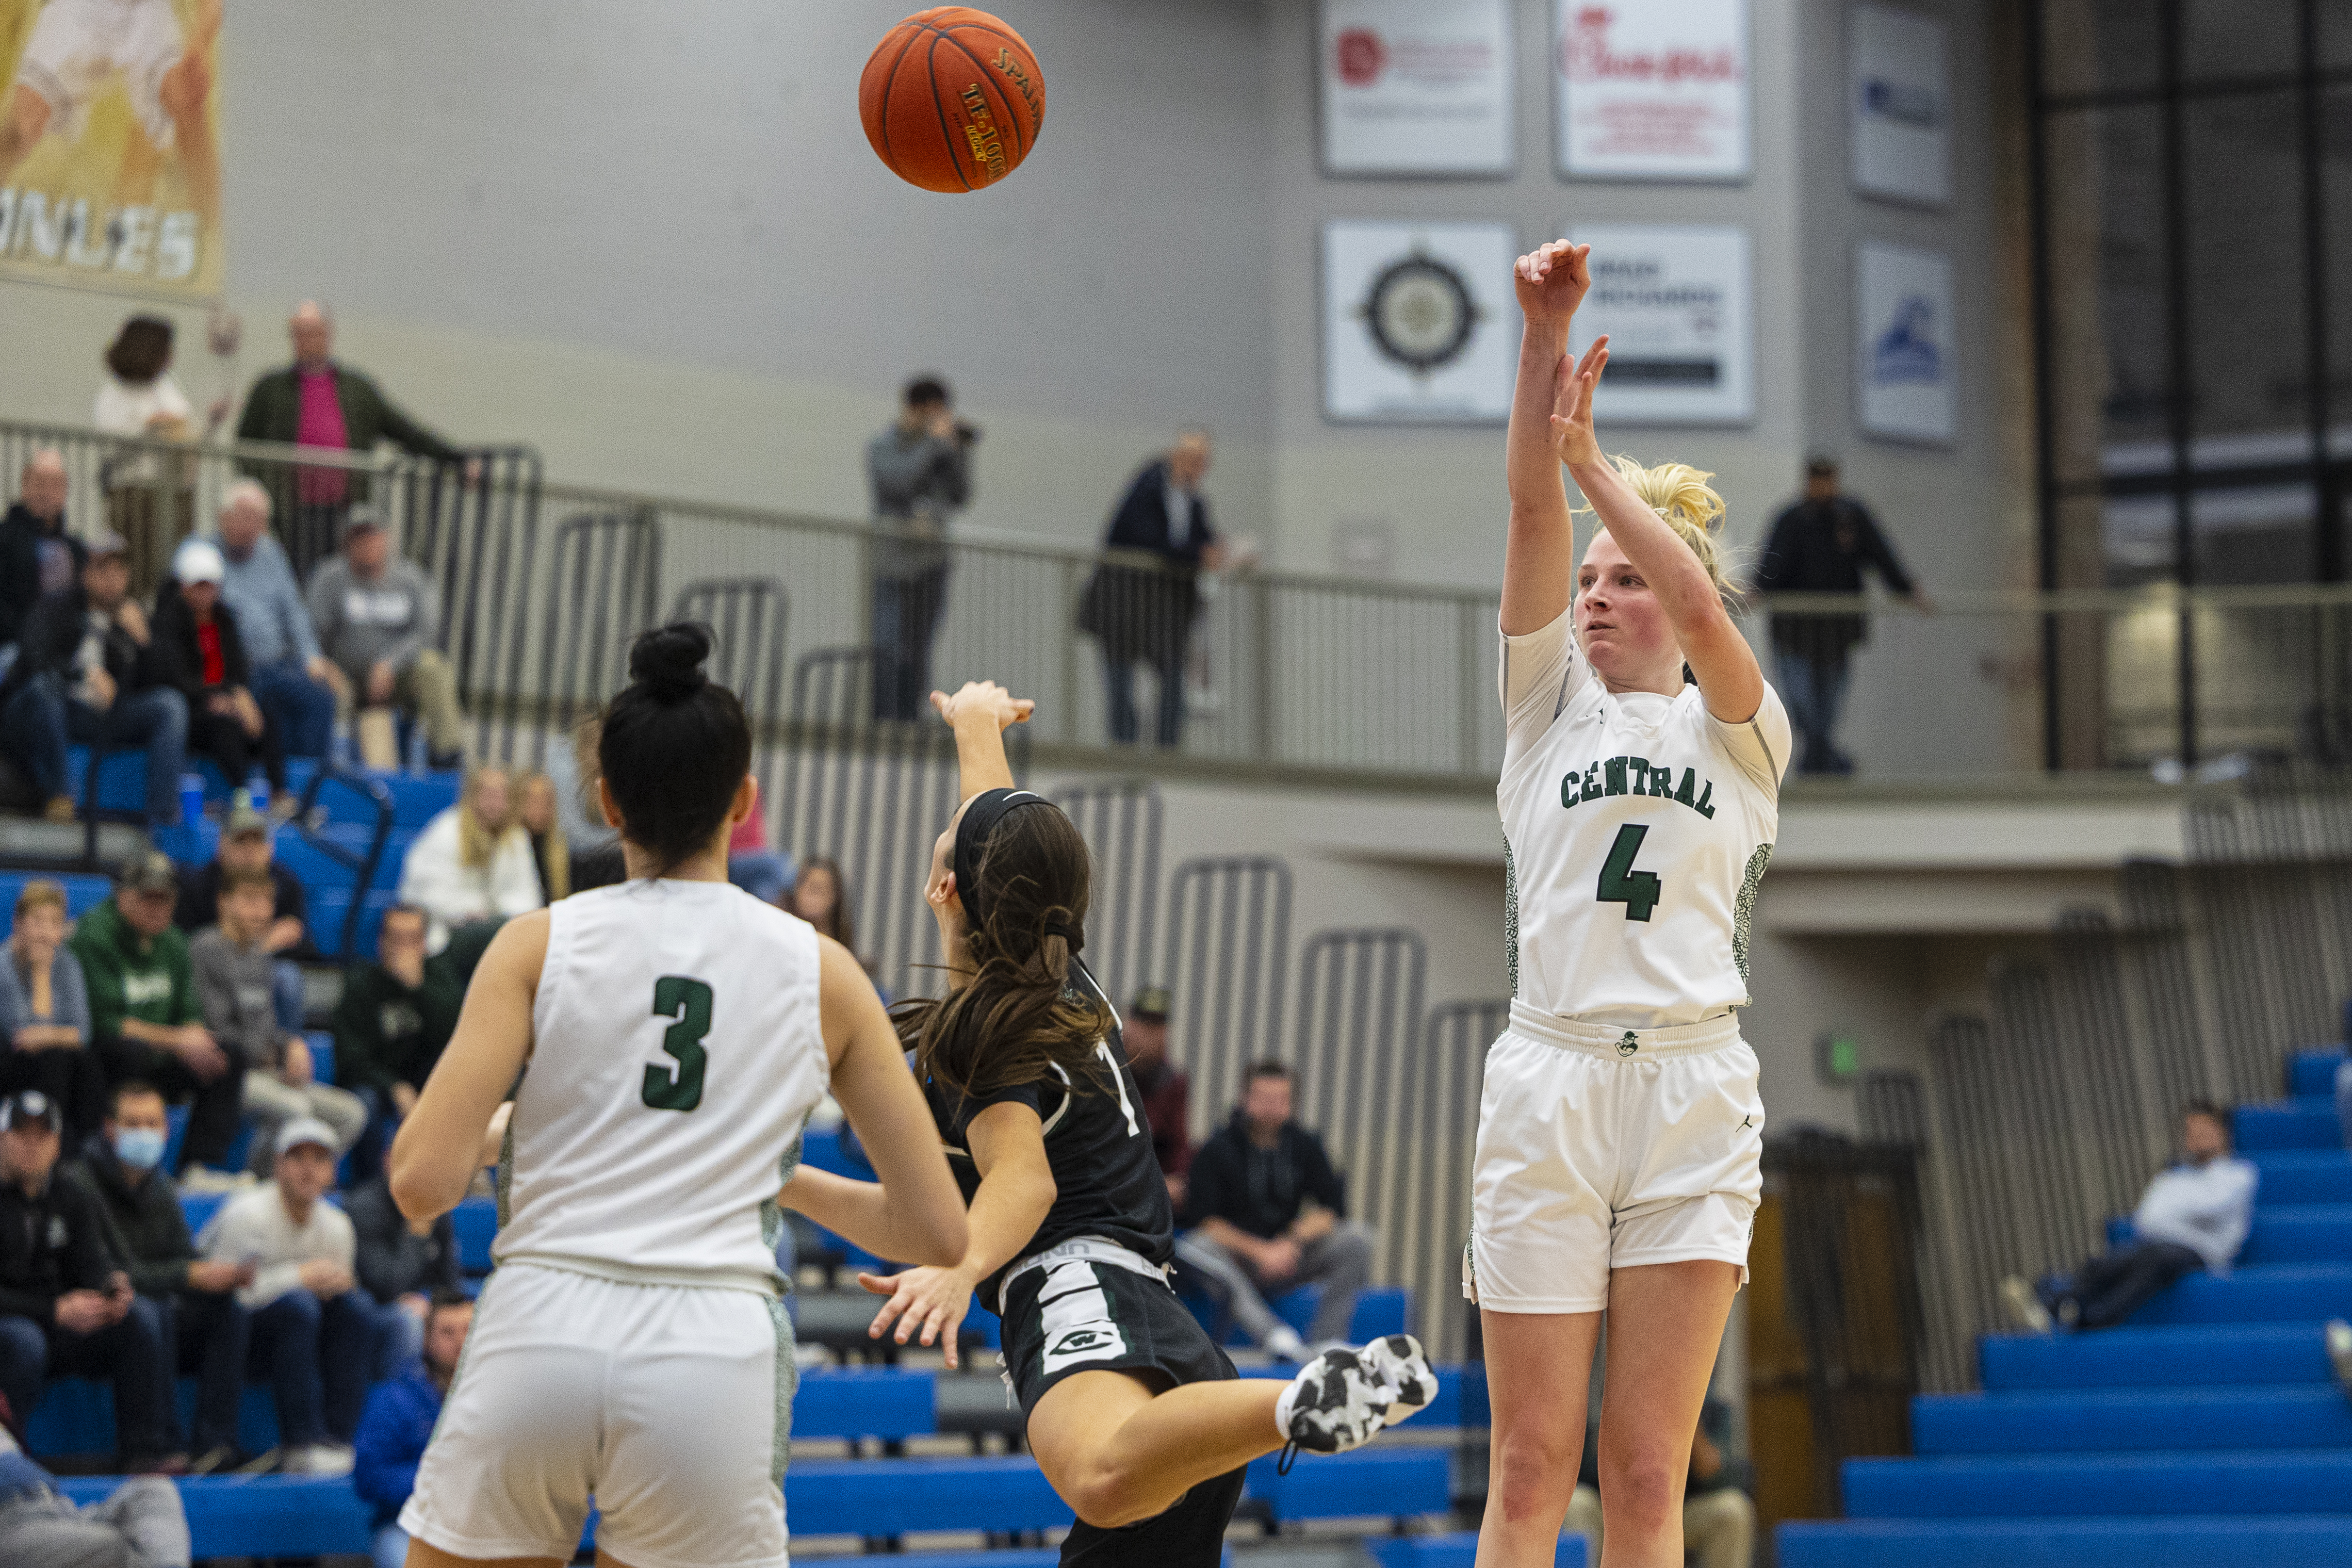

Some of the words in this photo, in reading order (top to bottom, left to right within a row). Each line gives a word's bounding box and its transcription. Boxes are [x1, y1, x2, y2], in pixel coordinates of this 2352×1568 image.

[1560, 755, 1717, 821] CENTRAL
[1596, 823, 1662, 923] 4
[641, 974, 715, 1112] 3
